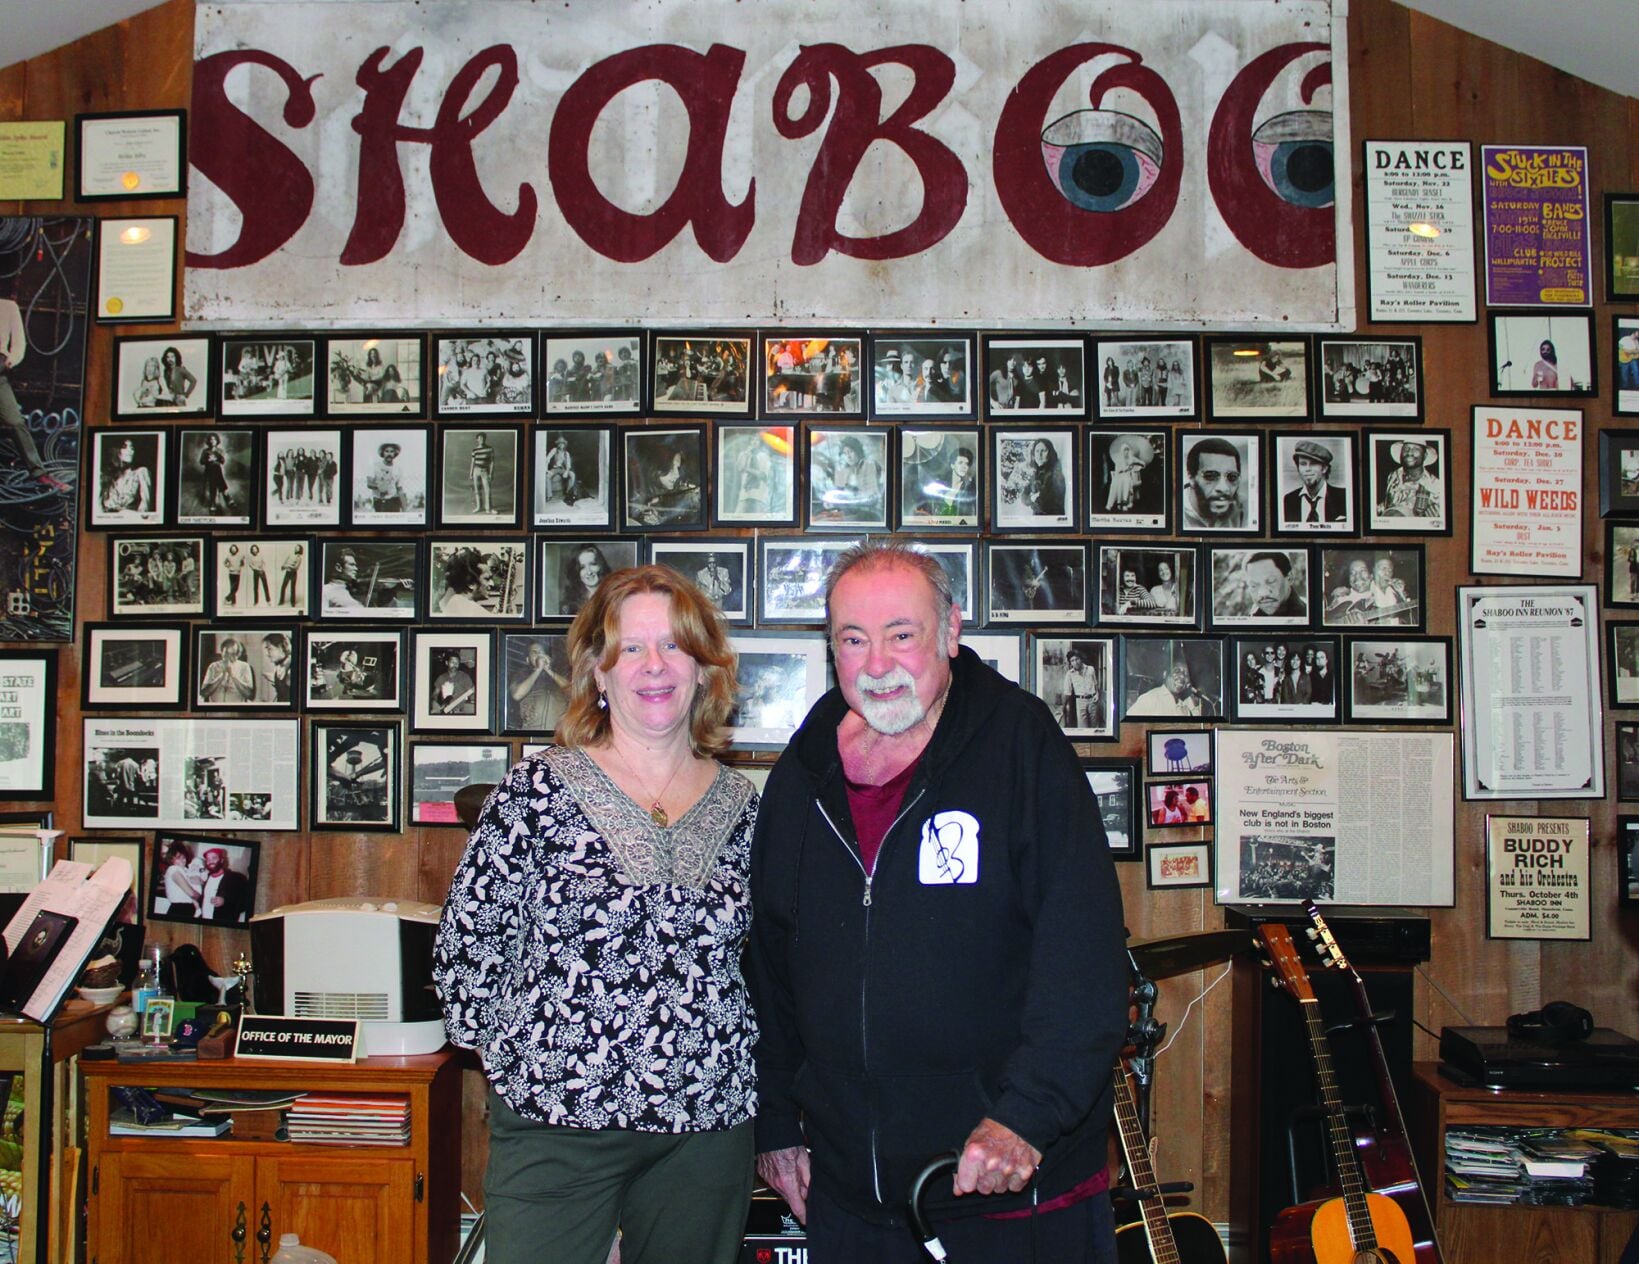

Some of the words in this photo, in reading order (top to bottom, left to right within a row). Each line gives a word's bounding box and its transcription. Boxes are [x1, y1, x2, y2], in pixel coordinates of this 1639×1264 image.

[187, 42, 1336, 269] SHABOO
[1375, 150, 1465, 170] DANCE
[1549, 154, 1561, 167] IN
[1563, 152, 1583, 172] THE
[1542, 202, 1584, 220] BANDS
[1514, 248, 1537, 257] CLUB
[1540, 257, 1582, 268] PROJECT
[1486, 418, 1577, 441] DANCE
[1493, 449, 1530, 457] Saturday,
[1494, 476, 1531, 484] Saturday,
[1480, 488, 1519, 509] WILD
[1526, 489, 1577, 511] WEEDS
[1493, 523, 1530, 531] Saturday,
[1486, 549, 1507, 557] Ray's
[1520, 600, 1535, 608] THE
[1482, 608, 1514, 617] SHABOO
[1515, 608, 1529, 617] INN
[1530, 608, 1562, 617] REUNION
[1564, 608, 1574, 617] '87
[2, 676, 34, 687] STATE
[1261, 739, 1310, 754] Boston
[1241, 751, 1283, 769] After
[1282, 753, 1324, 769] Dark
[1281, 775, 1298, 785] Arts
[1244, 785, 1298, 796] Entertainment
[1298, 787, 1328, 797] Section
[1240, 809, 1258, 818] New
[1262, 810, 1301, 819] England's
[1304, 810, 1334, 820] biggest
[1243, 819, 1261, 827] club
[1265, 819, 1272, 827] is
[1275, 820, 1288, 828] not
[1291, 820, 1299, 828] in
[1303, 820, 1331, 829] Boston
[1507, 822, 1533, 834] SHABOO
[1537, 822, 1570, 835] PRESENTS
[1504, 838, 1573, 853] BUDDY
[1514, 853, 1563, 868] RICH
[1500, 869, 1515, 886] and
[1520, 869, 1533, 886] his
[1537, 869, 1578, 887] Orchestra
[1500, 890, 1526, 898] Thurs.
[1529, 890, 1561, 899] October
[1564, 891, 1579, 899] 4th
[241, 1031, 276, 1042] OFFICE
[277, 1032, 292, 1043] OF
[293, 1033, 313, 1043] THE
[314, 1033, 352, 1045] MAYOR
[774, 1247, 809, 1264] TH
